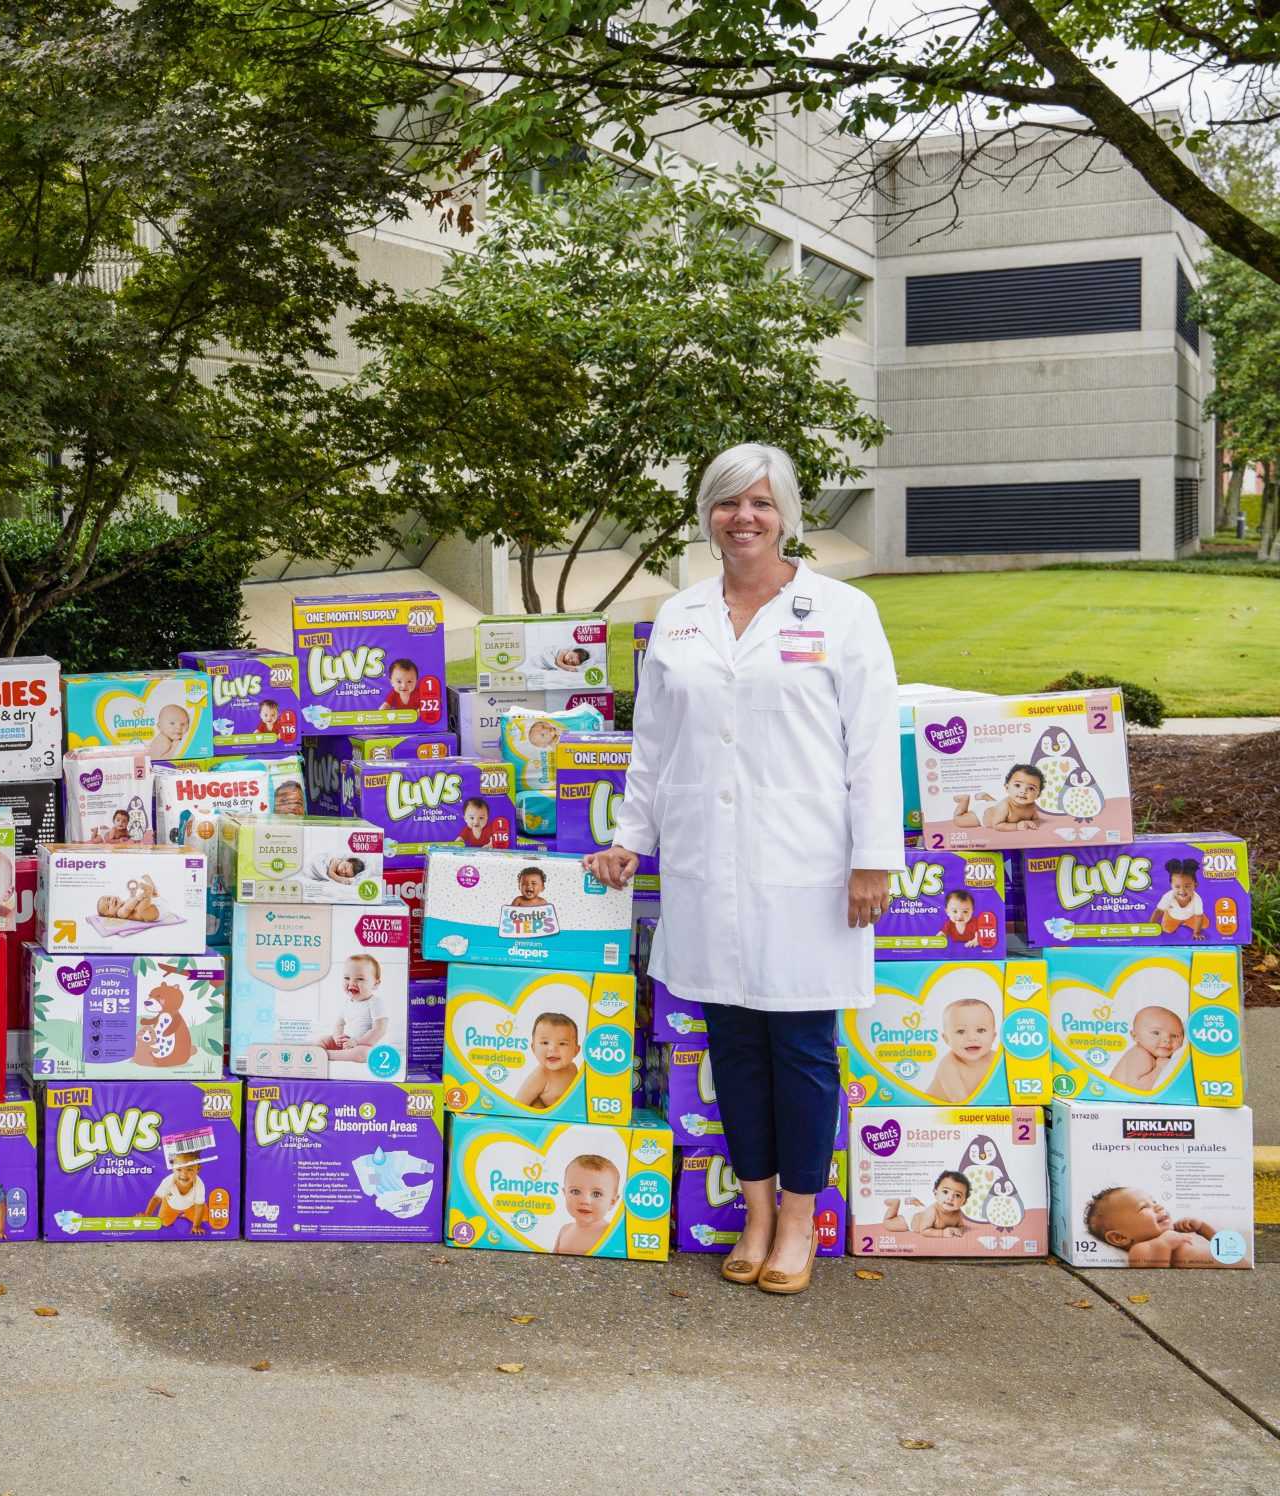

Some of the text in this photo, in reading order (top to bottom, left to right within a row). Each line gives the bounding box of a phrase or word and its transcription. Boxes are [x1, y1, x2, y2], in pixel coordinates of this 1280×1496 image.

[306, 609, 397, 623] ONE MONTH SUPPLY
[408, 611, 436, 627] 20X
[304, 634, 330, 646] NEW!
[270, 669, 293, 682] 20X
[308, 645, 386, 695] Luvs
[212, 673, 262, 706] Luvs
[421, 700, 439, 711] 252
[1028, 703, 1084, 716] super value
[1, 711, 12, 721] &
[13, 709, 36, 724] dry
[113, 714, 155, 729] Pampers
[1093, 713, 1107, 730] 2
[973, 722, 1031, 736] Diapers
[43, 751, 55, 767] 3
[575, 752, 632, 764] ONE MONT
[481, 772, 508, 787] 20X
[176, 780, 260, 801] HUGGIES
[387, 771, 462, 821] Luvs
[562, 786, 590, 797] NEW!
[932, 834, 945, 849] 2
[259, 846, 298, 855] DIAPERS
[55, 857, 106, 871] diapers
[1030, 859, 1057, 870] NEW!
[1203, 855, 1237, 872] 20X
[966, 863, 995, 880] 20X
[1056, 853, 1152, 910] Luvs
[900, 900, 923, 908] Triple
[1091, 902, 1148, 912] Leakguards
[1102, 896, 1128, 905] Triple
[509, 909, 546, 923] Gentle
[1216, 915, 1236, 924] 104
[362, 919, 391, 931] SAVE
[502, 918, 555, 934] STEPS
[256, 933, 321, 947] DIAPERS
[362, 932, 388, 944] $800
[979, 929, 996, 938] 116
[508, 947, 549, 959] diapers
[101, 980, 120, 988] baby
[91, 987, 130, 997] diapers
[1061, 1012, 1128, 1034] Pampers
[465, 1026, 528, 1050] Pampers
[600, 1033, 620, 1041] SAVE
[871, 1022, 938, 1044] Pampers
[1007, 1032, 1043, 1046] $400
[1193, 1028, 1233, 1043] $400
[589, 1048, 625, 1062] $400
[675, 1052, 700, 1064] NEW!
[252, 1088, 278, 1099] NEW!
[1014, 1080, 1042, 1094] 152
[1201, 1081, 1233, 1096] 192
[54, 1089, 89, 1105] NEW!
[203, 1095, 232, 1111] 20X
[407, 1095, 434, 1110] 20X
[592, 1098, 621, 1112] 168
[255, 1099, 357, 1147] Luvs with
[959, 1112, 1010, 1123] super value
[334, 1119, 418, 1134] Absorption Areas
[1018, 1125, 1030, 1141] 2
[1126, 1121, 1192, 1132] KIRKLAND
[57, 1105, 162, 1174] Luvs
[907, 1129, 961, 1142] Diapers
[1092, 1143, 1227, 1153] diapers couches pañales
[106, 1158, 134, 1169] Triple
[684, 1158, 707, 1168] NEW!
[93, 1165, 156, 1176] Leakguards
[490, 1169, 559, 1196] Pampers
[629, 1193, 664, 1207] $400
[7, 1207, 26, 1217] 144
[210, 1208, 229, 1218] 168
[632, 1234, 659, 1248] 132
[862, 1237, 874, 1252] 2
[1075, 1241, 1097, 1253] 192
